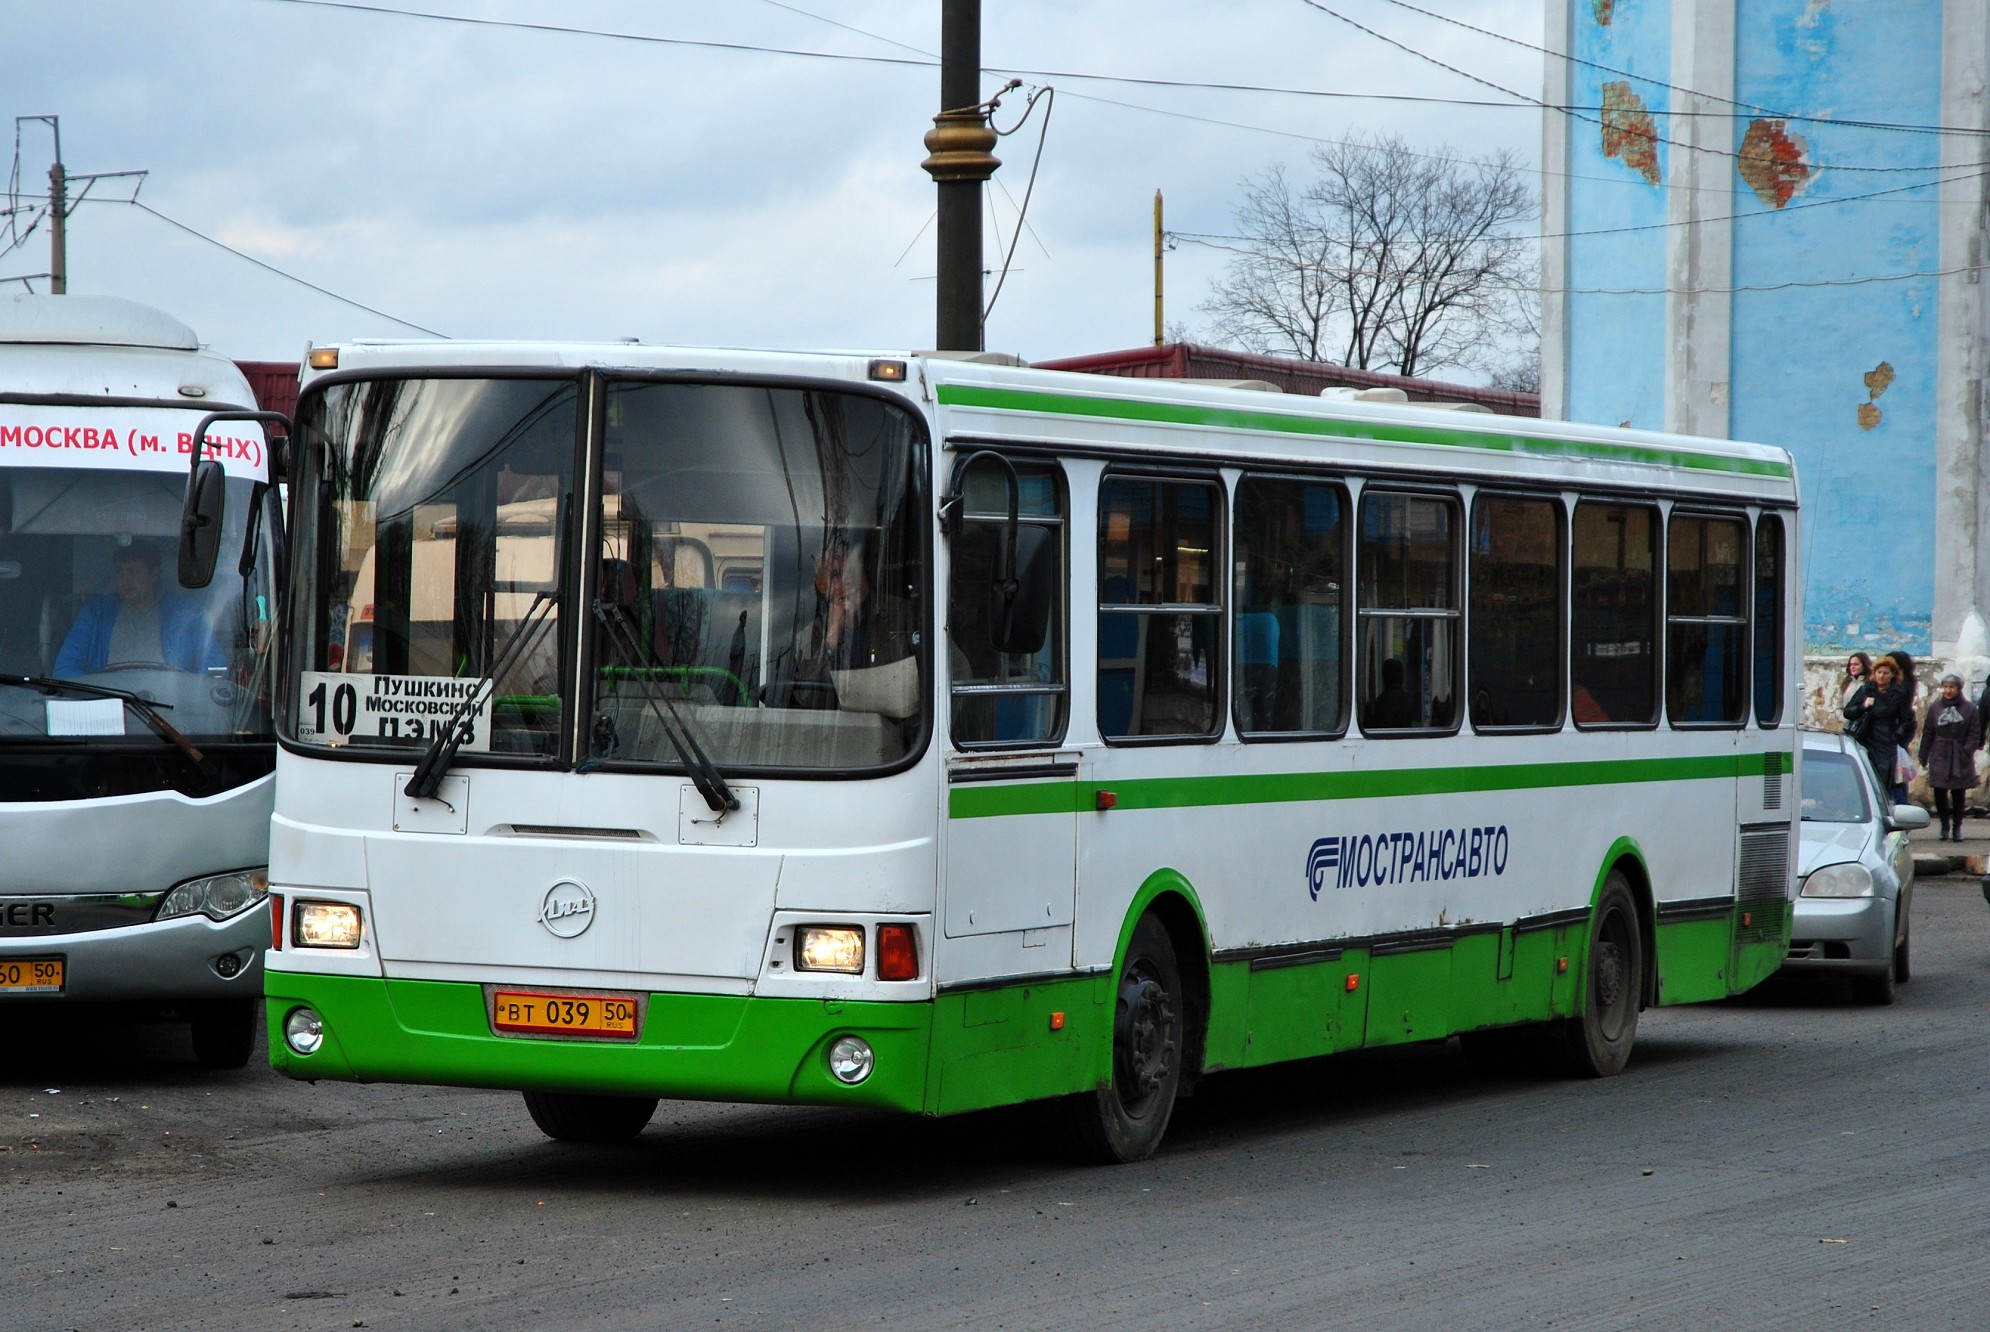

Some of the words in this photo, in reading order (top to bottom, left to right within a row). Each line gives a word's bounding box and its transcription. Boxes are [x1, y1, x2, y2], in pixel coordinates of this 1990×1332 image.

[0, 425, 119, 450] МОСКВА
[127, 428, 167, 457] (м.
[177, 432, 261, 468] ВДНХ)
[308, 682, 357, 736] 10
[1336, 824, 1509, 890] МОСТРАНСАВТО
[0, 903, 56, 927] ER
[34, 963, 55, 978] 50
[546, 1000, 590, 1026] 039
[604, 1003, 627, 1021] 50
[606, 1021, 624, 1029] RUS
